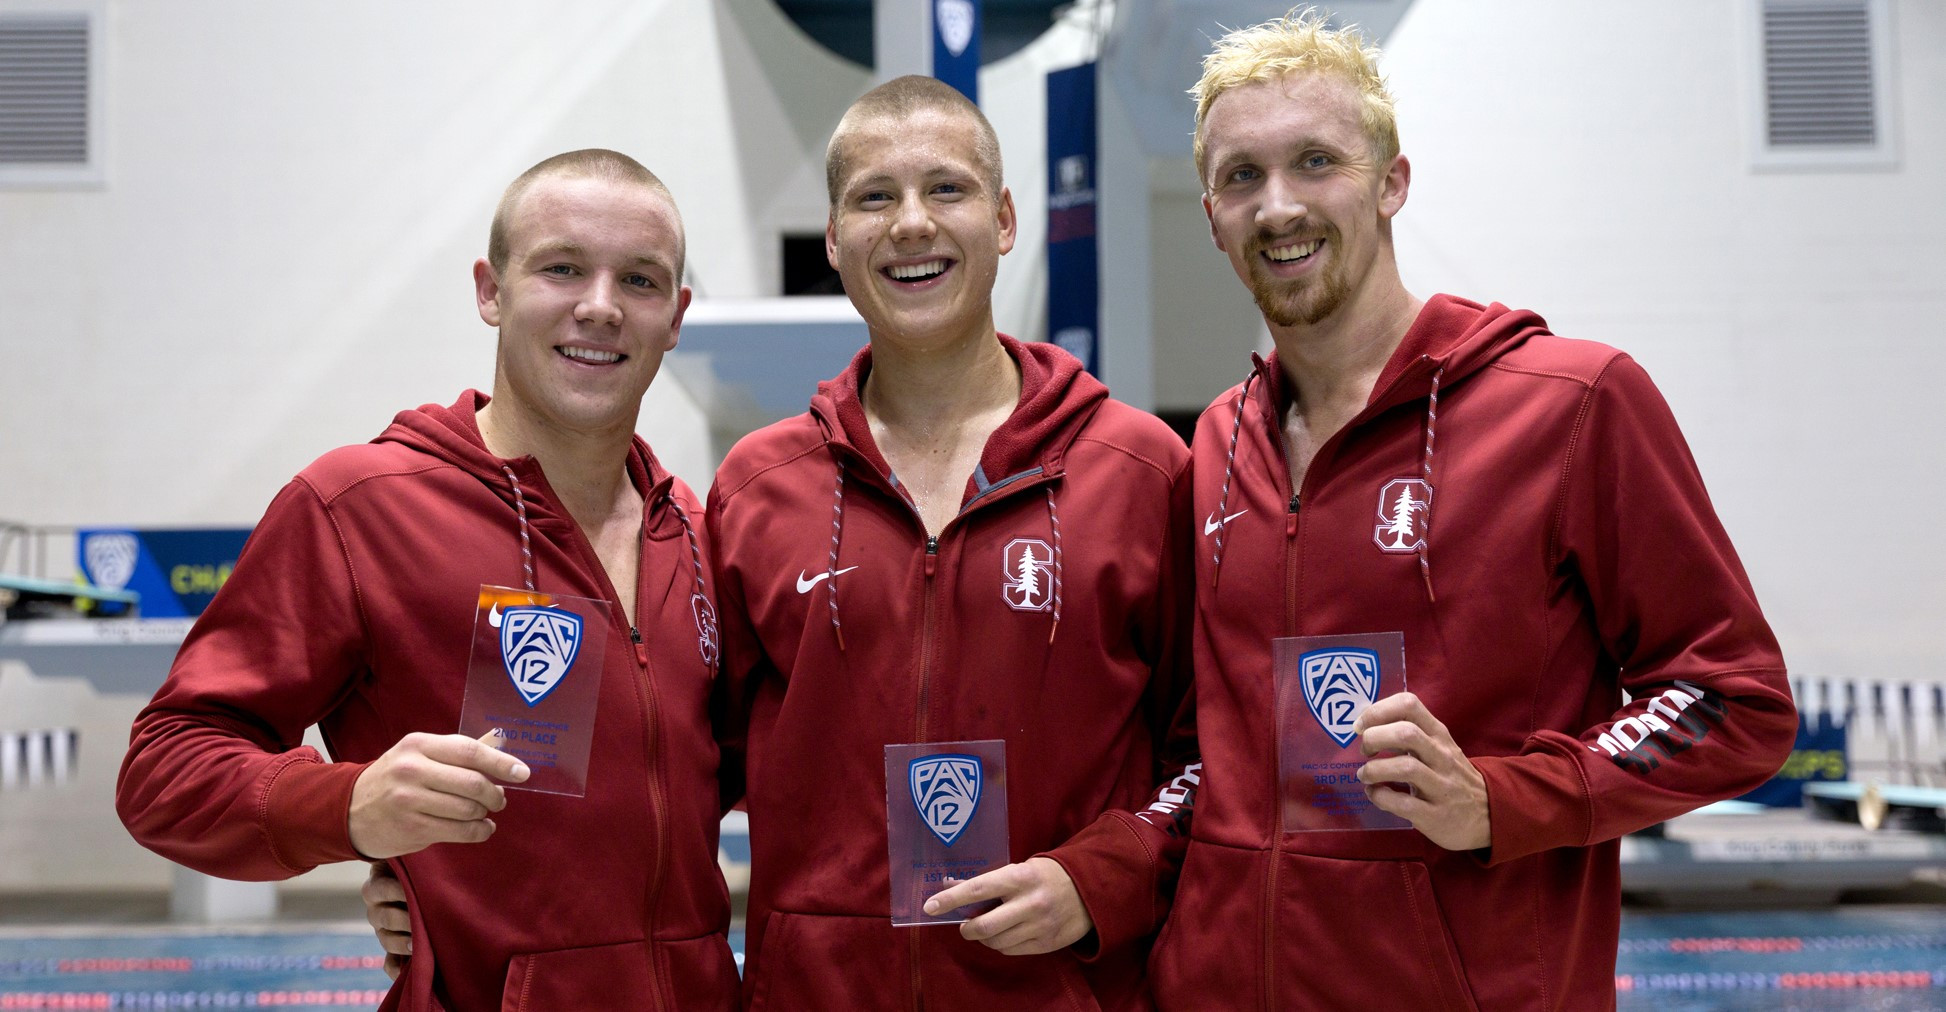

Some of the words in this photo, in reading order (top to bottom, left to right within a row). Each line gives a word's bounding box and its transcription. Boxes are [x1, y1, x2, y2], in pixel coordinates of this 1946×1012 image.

[507, 613, 575, 665] PAC
[519, 658, 550, 686] 12
[1305, 655, 1373, 710] PAC
[1327, 699, 1356, 726] 12
[493, 727, 518, 741] 2ND
[521, 731, 557, 745] PLACE
[914, 761, 976, 811] PAC
[1339, 773, 1363, 785] PLA
[933, 802, 960, 827] 12
[923, 872, 944, 883] 1ST
